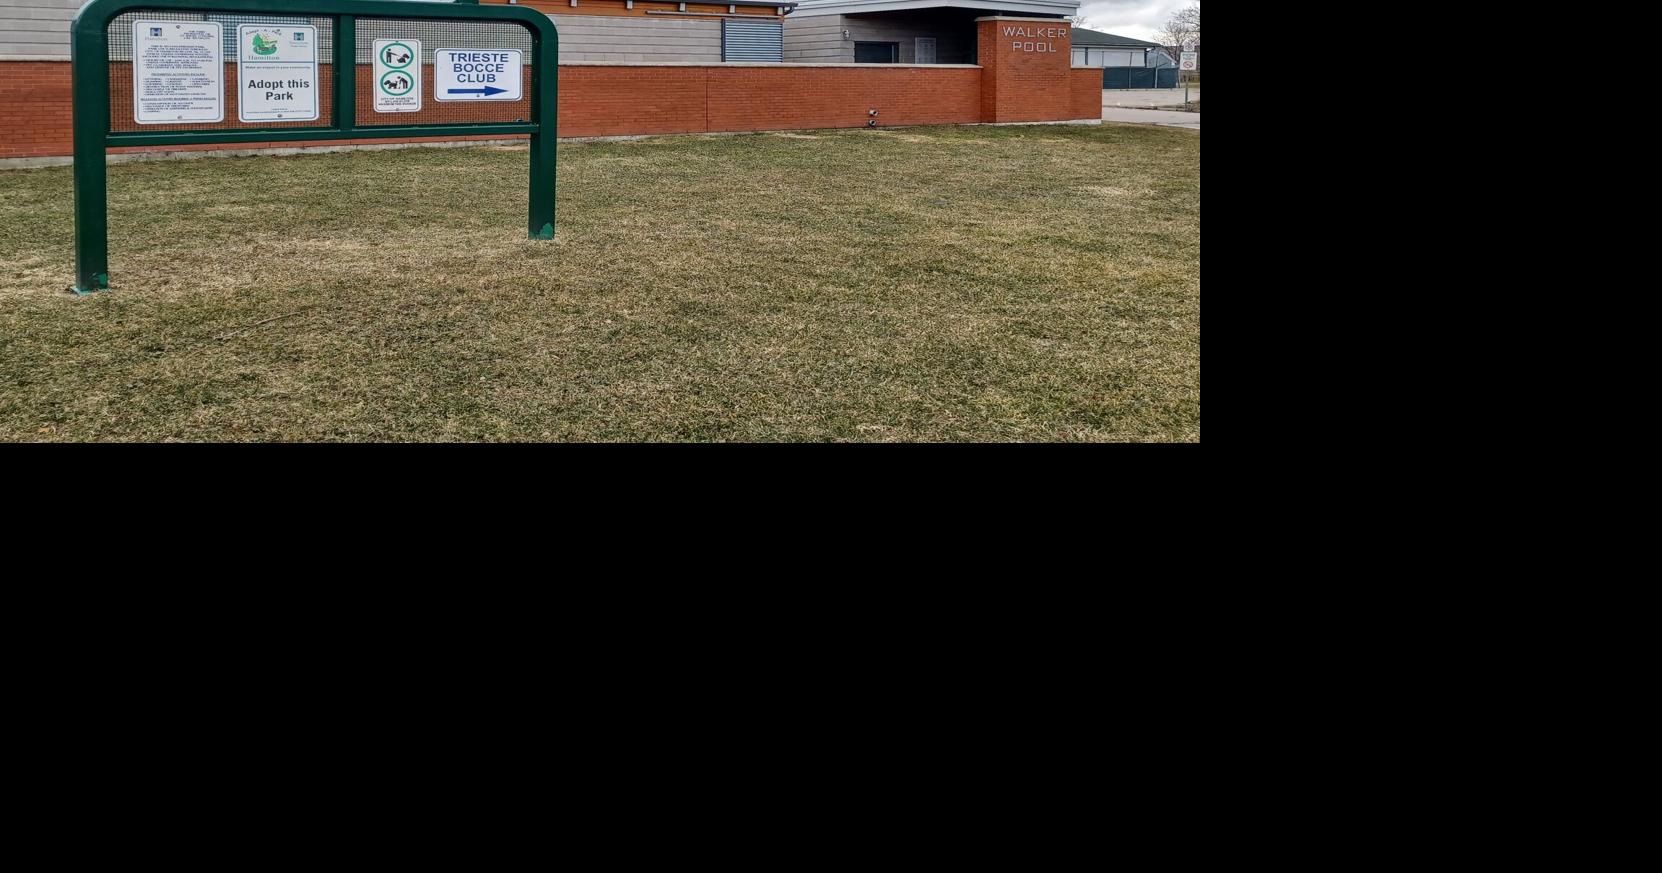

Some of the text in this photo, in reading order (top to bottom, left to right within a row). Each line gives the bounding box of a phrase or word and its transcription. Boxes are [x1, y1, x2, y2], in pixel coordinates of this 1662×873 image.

[1003, 26, 1067, 38] WALKER
[1012, 41, 1057, 52] POOL
[448, 52, 509, 62] TRIESTE
[453, 63, 504, 73] BOCCE
[456, 73, 496, 82] CLUB
[248, 79, 310, 90] Adopt this
[265, 91, 293, 101] Park
